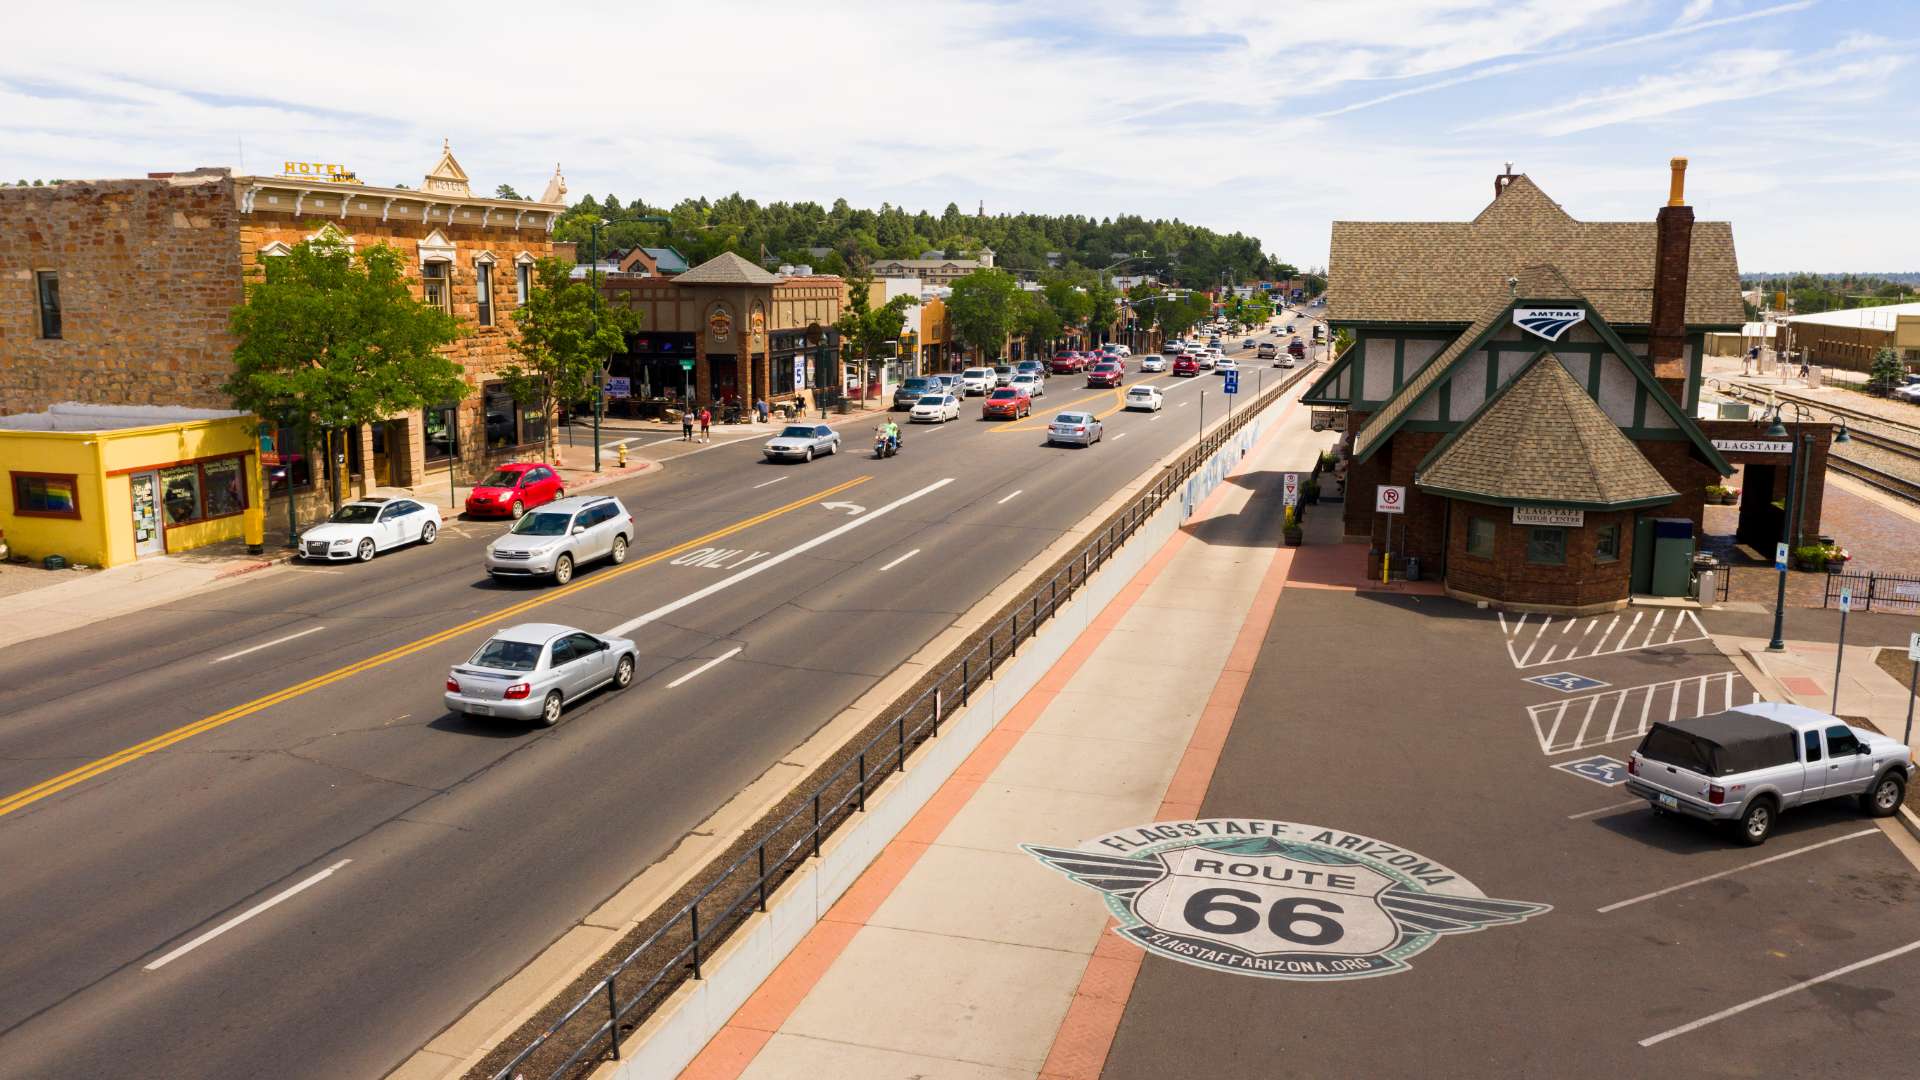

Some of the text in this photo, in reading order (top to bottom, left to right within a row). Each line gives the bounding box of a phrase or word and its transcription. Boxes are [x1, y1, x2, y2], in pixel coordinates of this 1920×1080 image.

[284, 161, 345, 175] HOTEL
[1227, 371, 1236, 383] H
[1717, 441, 1786, 450] FLAGSTAFF
[1517, 507, 1580, 516] FLAGSTAFF
[670, 548, 770, 569] ONLY
[1100, 821, 1455, 885] FLAGSTAFF ARIZONA
[1194, 859, 1356, 889] ROUTE
[1184, 888, 1344, 945] 66
[1147, 932, 1372, 972] FLAGSTAFFARIZONA.ORG
